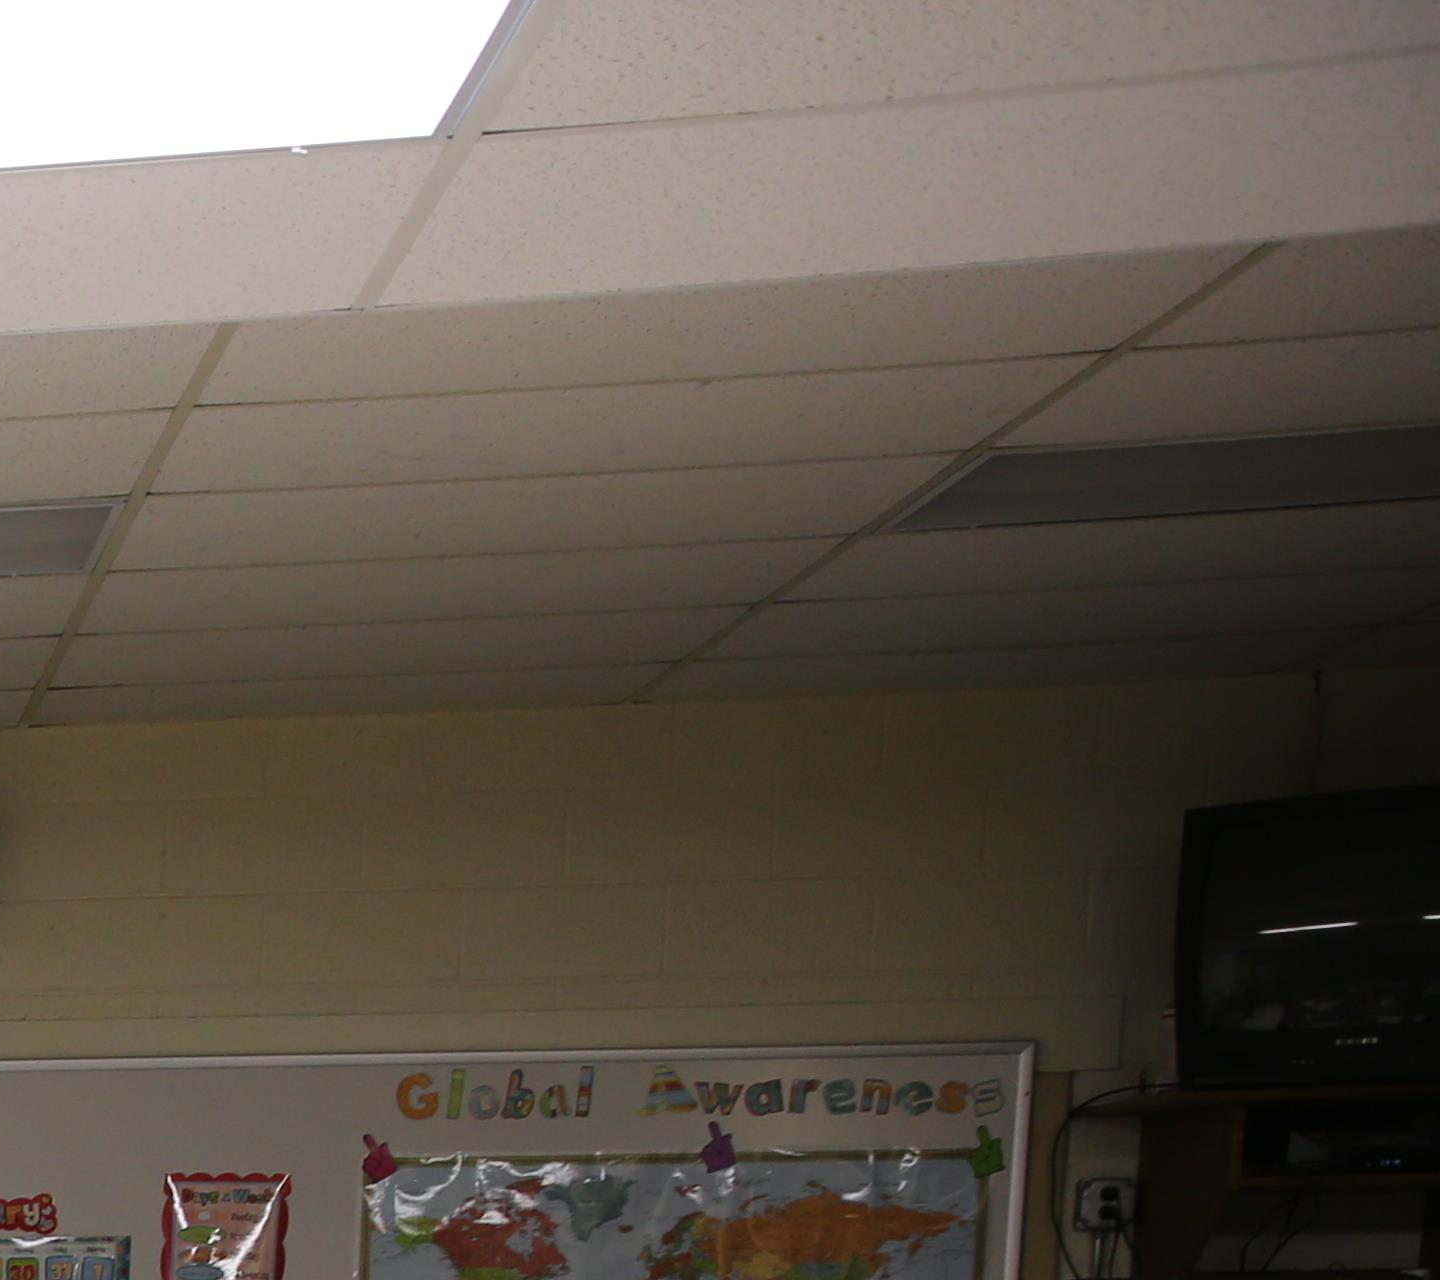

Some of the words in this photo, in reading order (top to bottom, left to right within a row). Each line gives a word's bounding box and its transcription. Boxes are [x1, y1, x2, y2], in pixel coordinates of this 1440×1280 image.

[396, 1065, 594, 1121] Global
[636, 1063, 1006, 1117] Awareness
[49, 1262, 71, 1280] 31
[93, 1263, 105, 1280] 1
